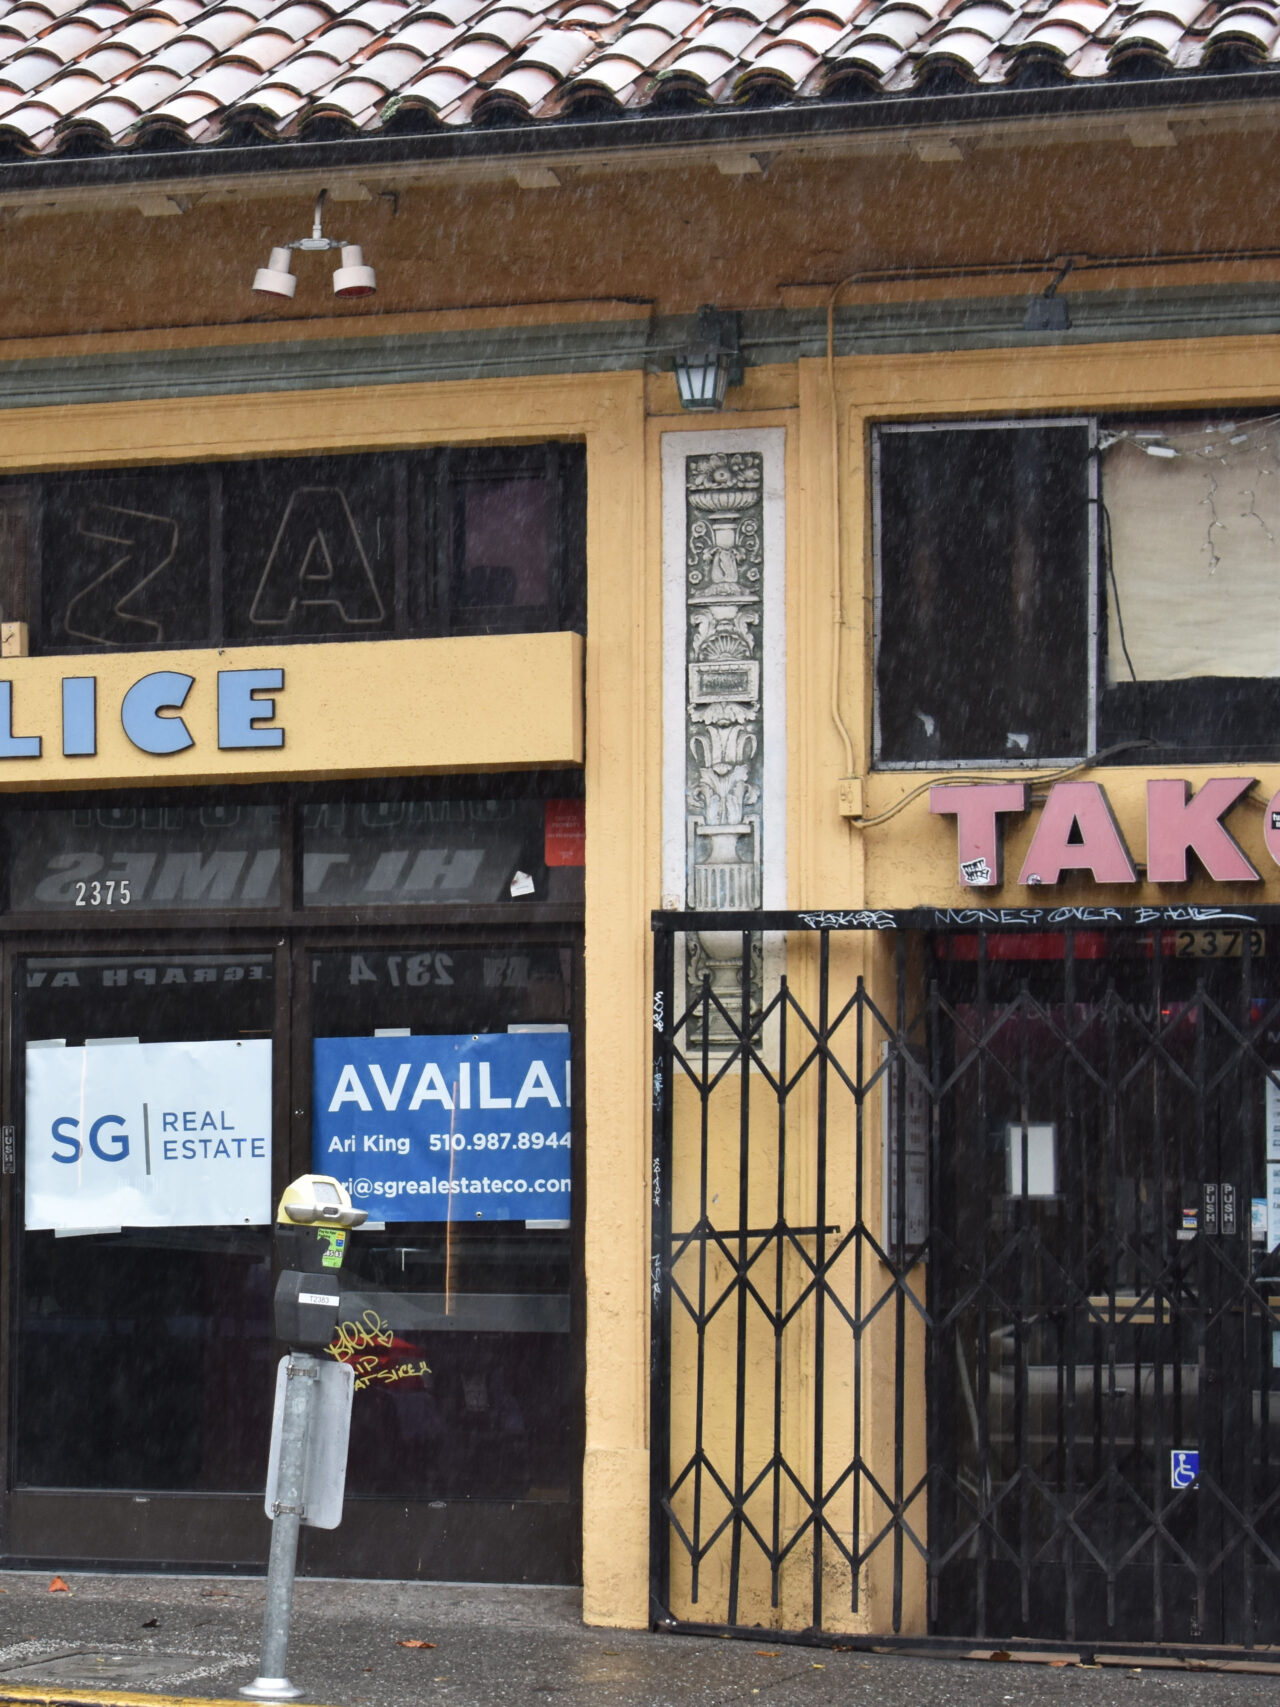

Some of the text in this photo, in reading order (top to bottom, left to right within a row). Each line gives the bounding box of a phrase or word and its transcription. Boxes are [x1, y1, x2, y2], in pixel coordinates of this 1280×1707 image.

[929, 777, 1280, 888] TAK
[74, 880, 131, 907] 2375
[933, 907, 1043, 926] MONEY
[1048, 905, 1122, 923] OVER
[1178, 930, 1264, 957] 2379
[327, 1060, 571, 1113] AVAILA
[163, 1111, 235, 1133] REAL
[51, 1114, 131, 1165] SG
[163, 1137, 267, 1162] ESTATE
[328, 1132, 571, 1155] Ari King 510.987.8944
[1205, 1185, 1216, 1223] PUSH
[1223, 1185, 1234, 1223] PUSH
[354, 1355, 379, 1375] IP
[354, 1374, 378, 1391] AT
